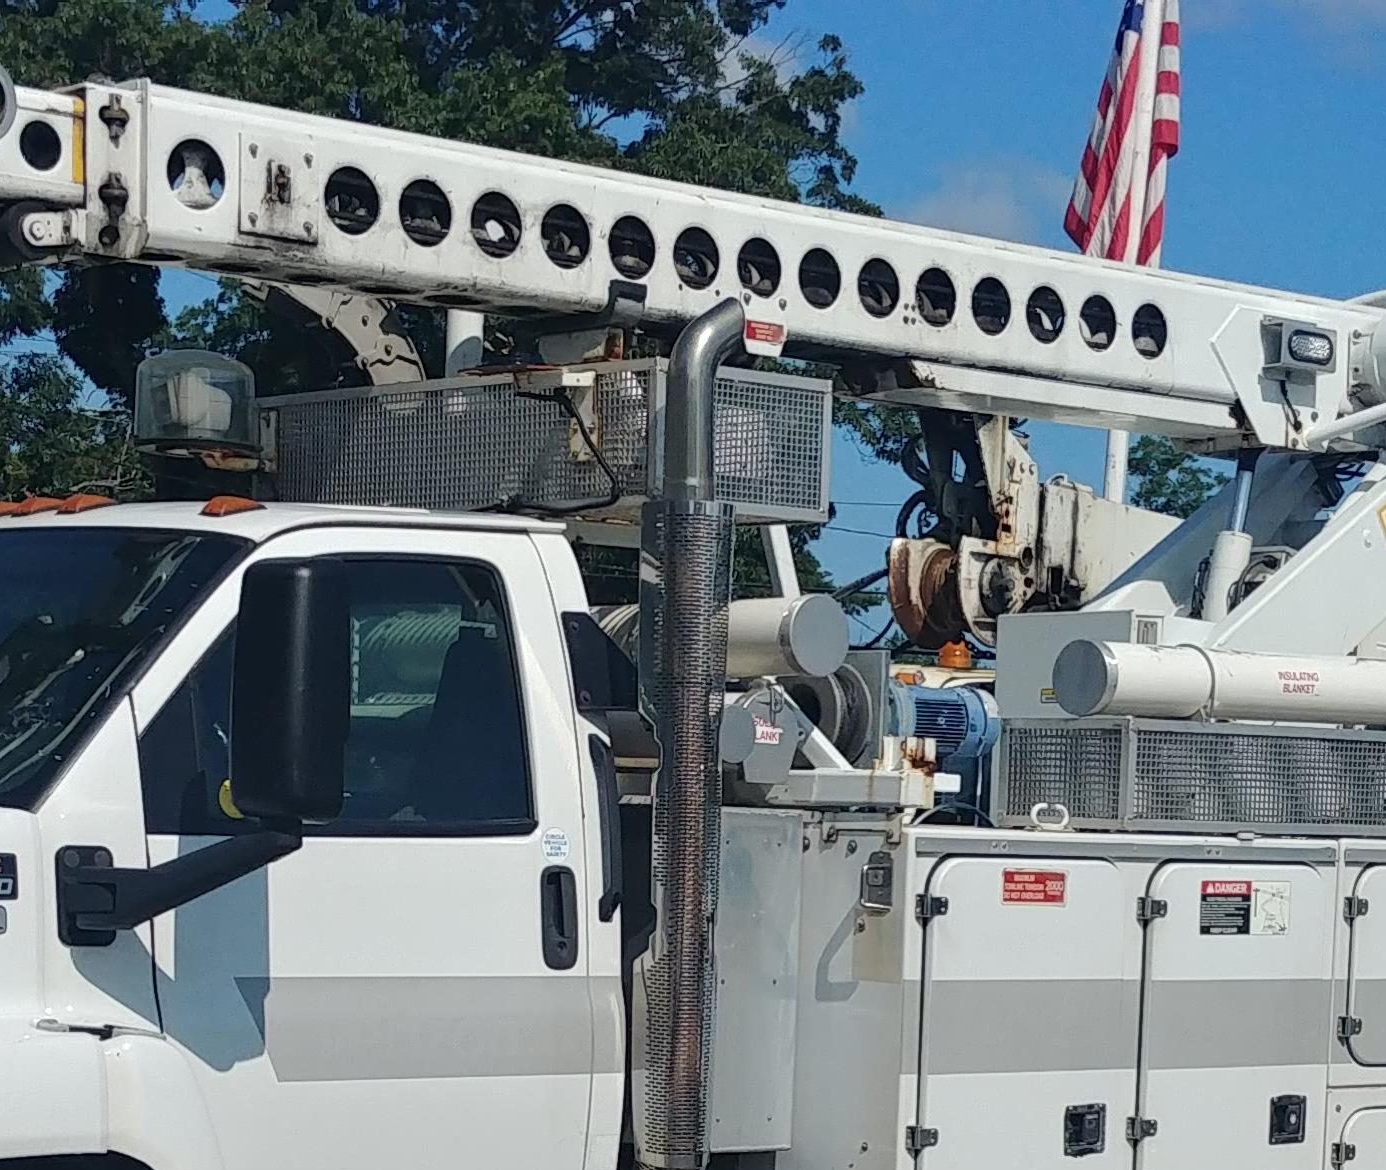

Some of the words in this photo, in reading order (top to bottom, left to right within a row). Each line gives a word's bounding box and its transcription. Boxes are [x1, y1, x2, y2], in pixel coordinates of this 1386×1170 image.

[1277, 671, 1319, 682] INSULATING
[1283, 683, 1316, 694] BLANKET
[1214, 882, 1248, 894] DANGER
